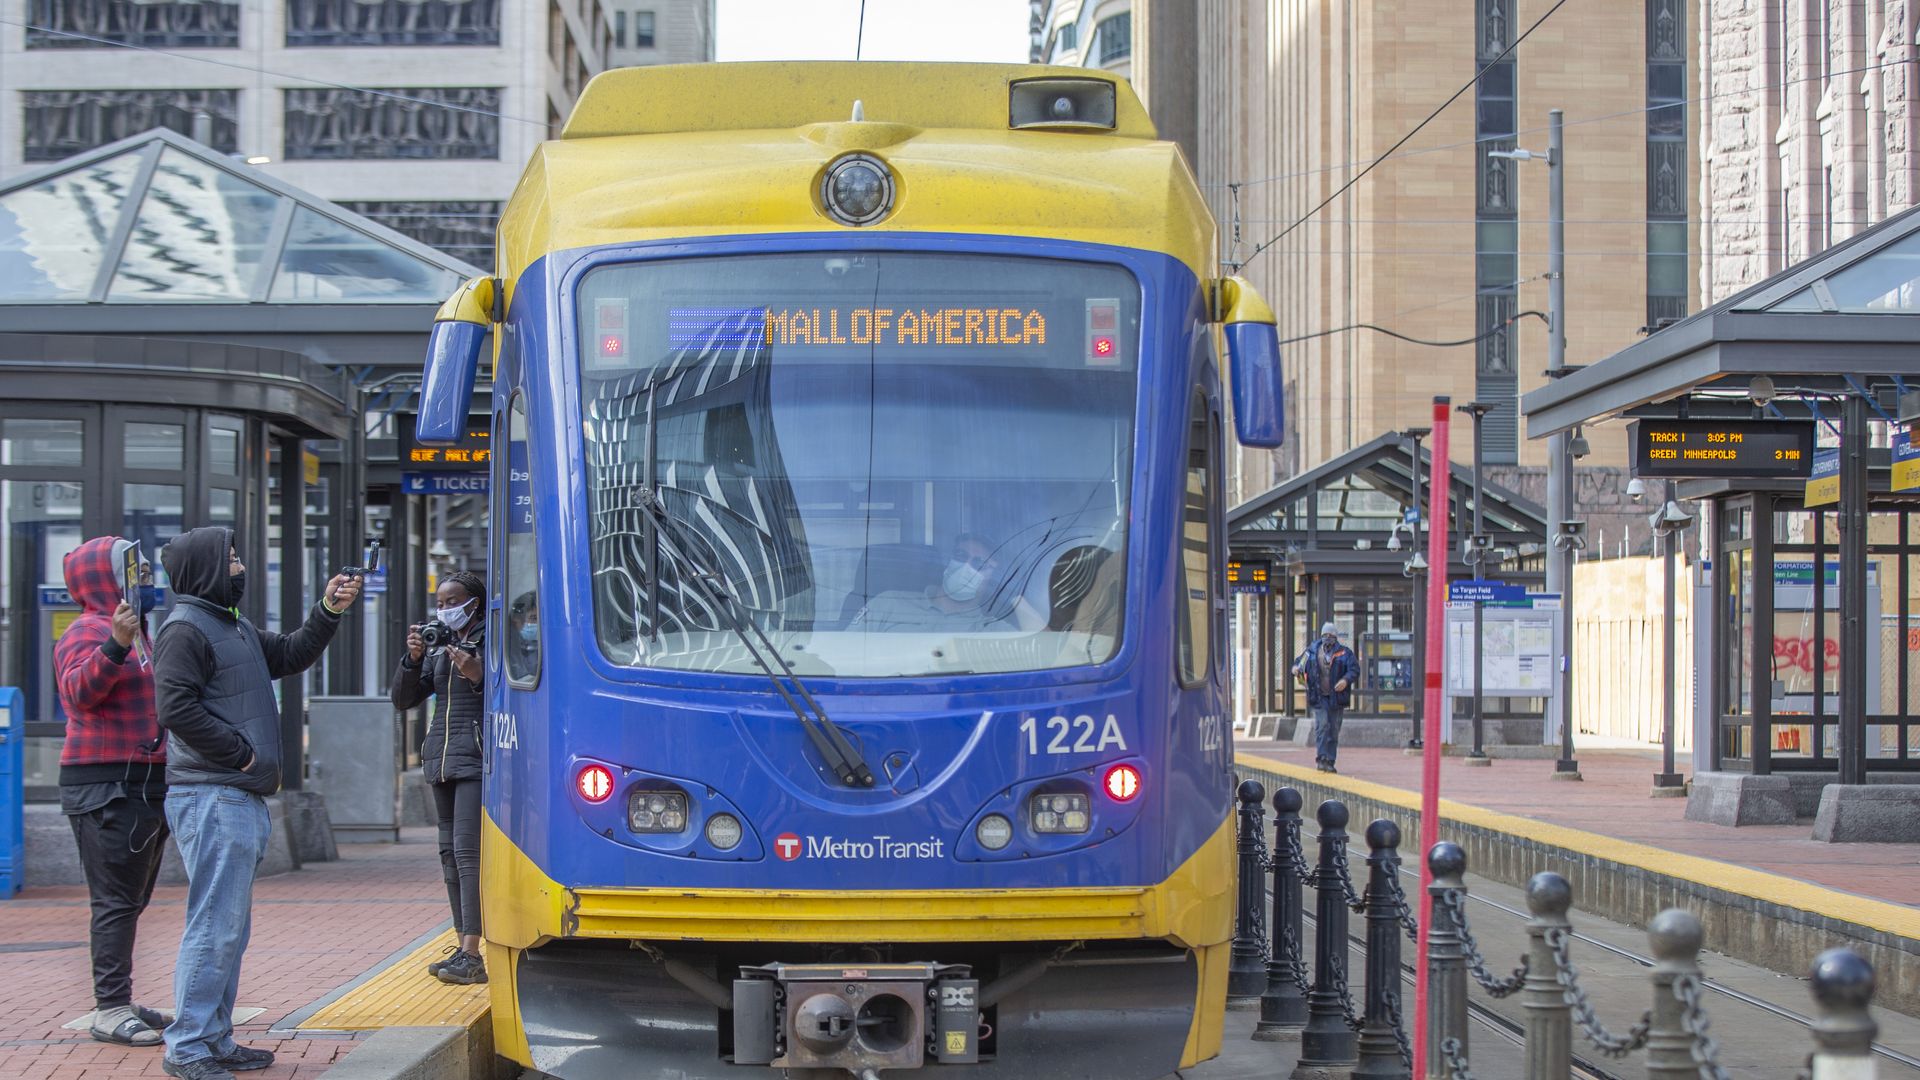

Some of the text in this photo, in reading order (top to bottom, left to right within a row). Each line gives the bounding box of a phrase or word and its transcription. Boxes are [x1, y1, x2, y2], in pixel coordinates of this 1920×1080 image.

[765, 308, 1047, 344] MALL OF AMERICA
[1650, 433, 1678, 442] TRACK
[1707, 433, 1726, 442] 3:05
[1729, 433, 1743, 443] PM
[1650, 450, 1800, 460] GREEN MINNEAPOLIS 3 MIN
[432, 477, 489, 490] TICKET
[1460, 586, 1477, 595] Target
[495, 713, 518, 750] 122A
[1020, 714, 1127, 755] 122A
[806, 836, 874, 858] Metro
[873, 836, 944, 858] Transit
